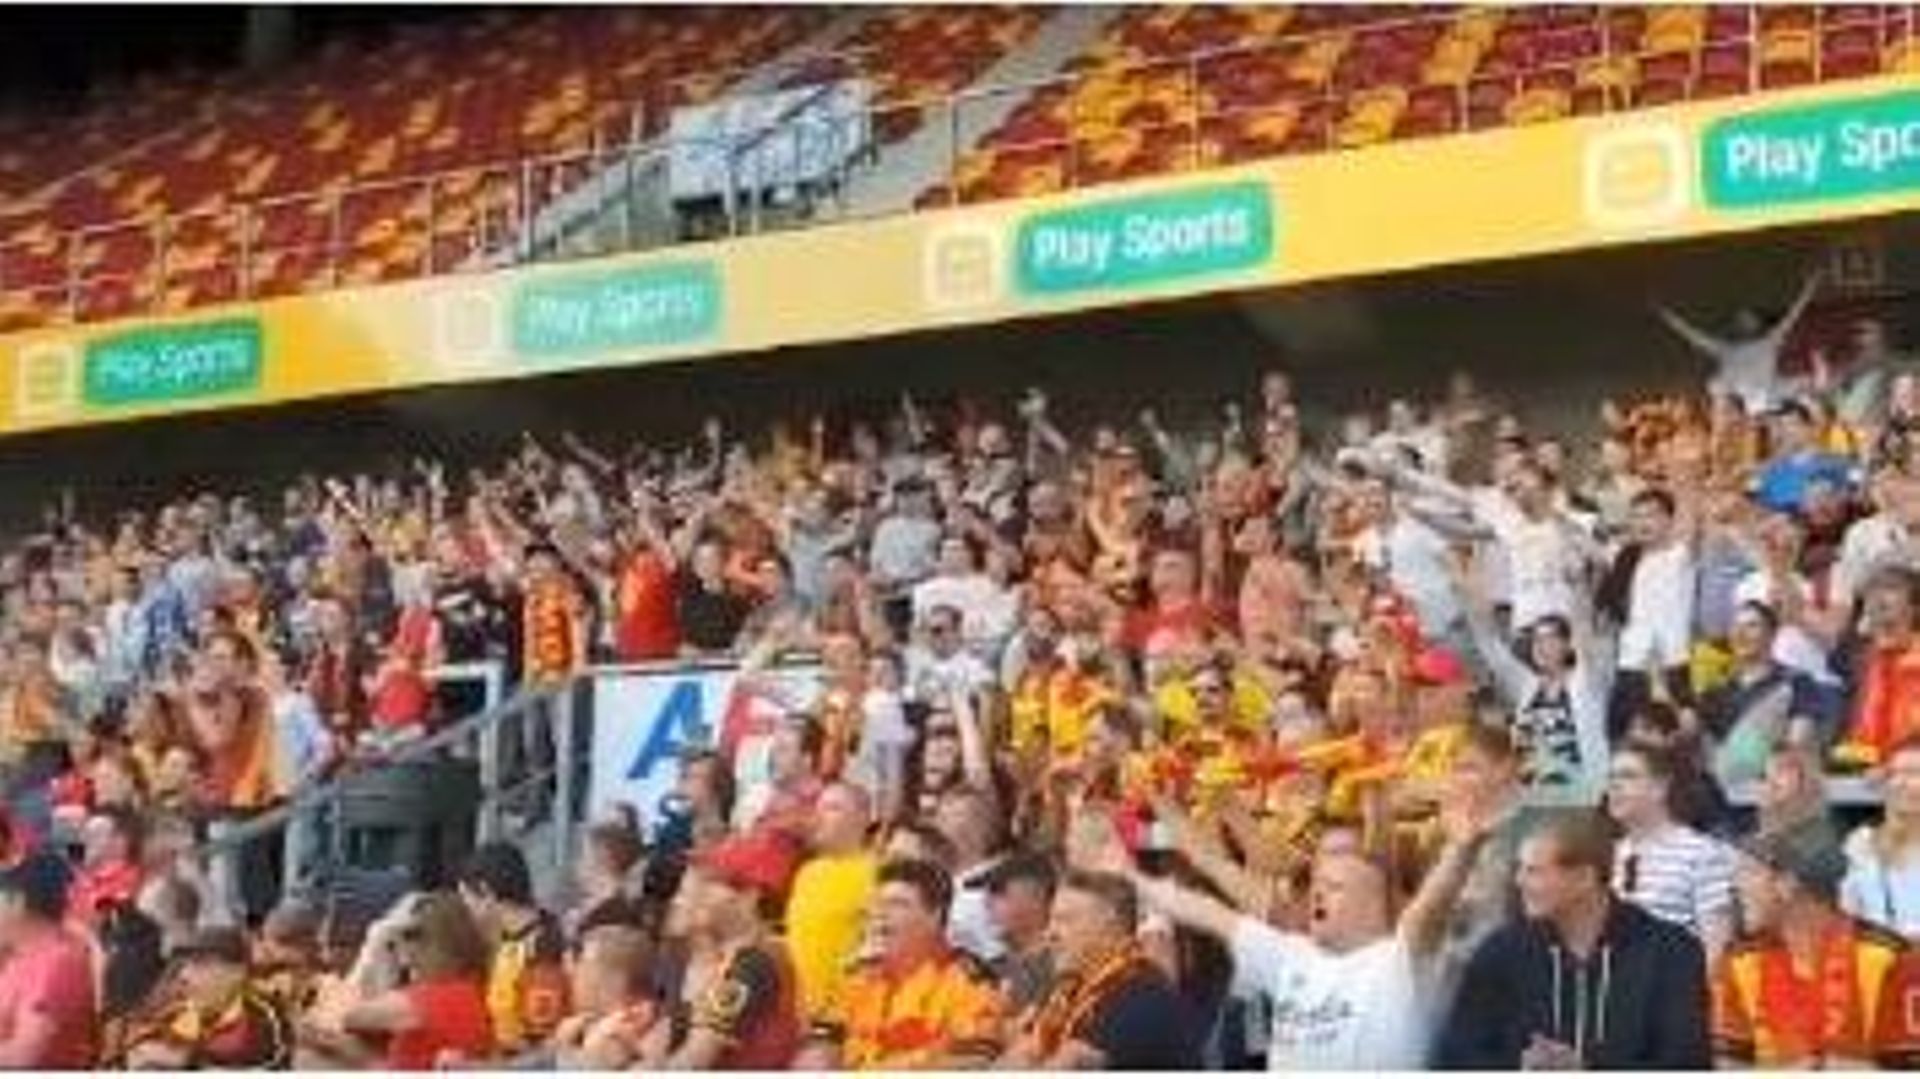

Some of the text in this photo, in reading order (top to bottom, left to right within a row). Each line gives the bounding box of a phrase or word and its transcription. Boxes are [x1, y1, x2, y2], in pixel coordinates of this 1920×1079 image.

[1726, 118, 1920, 184] Play Spo
[1034, 208, 1249, 270] Play Sports
[602, 281, 706, 329] Sports
[154, 337, 248, 384] Sports
